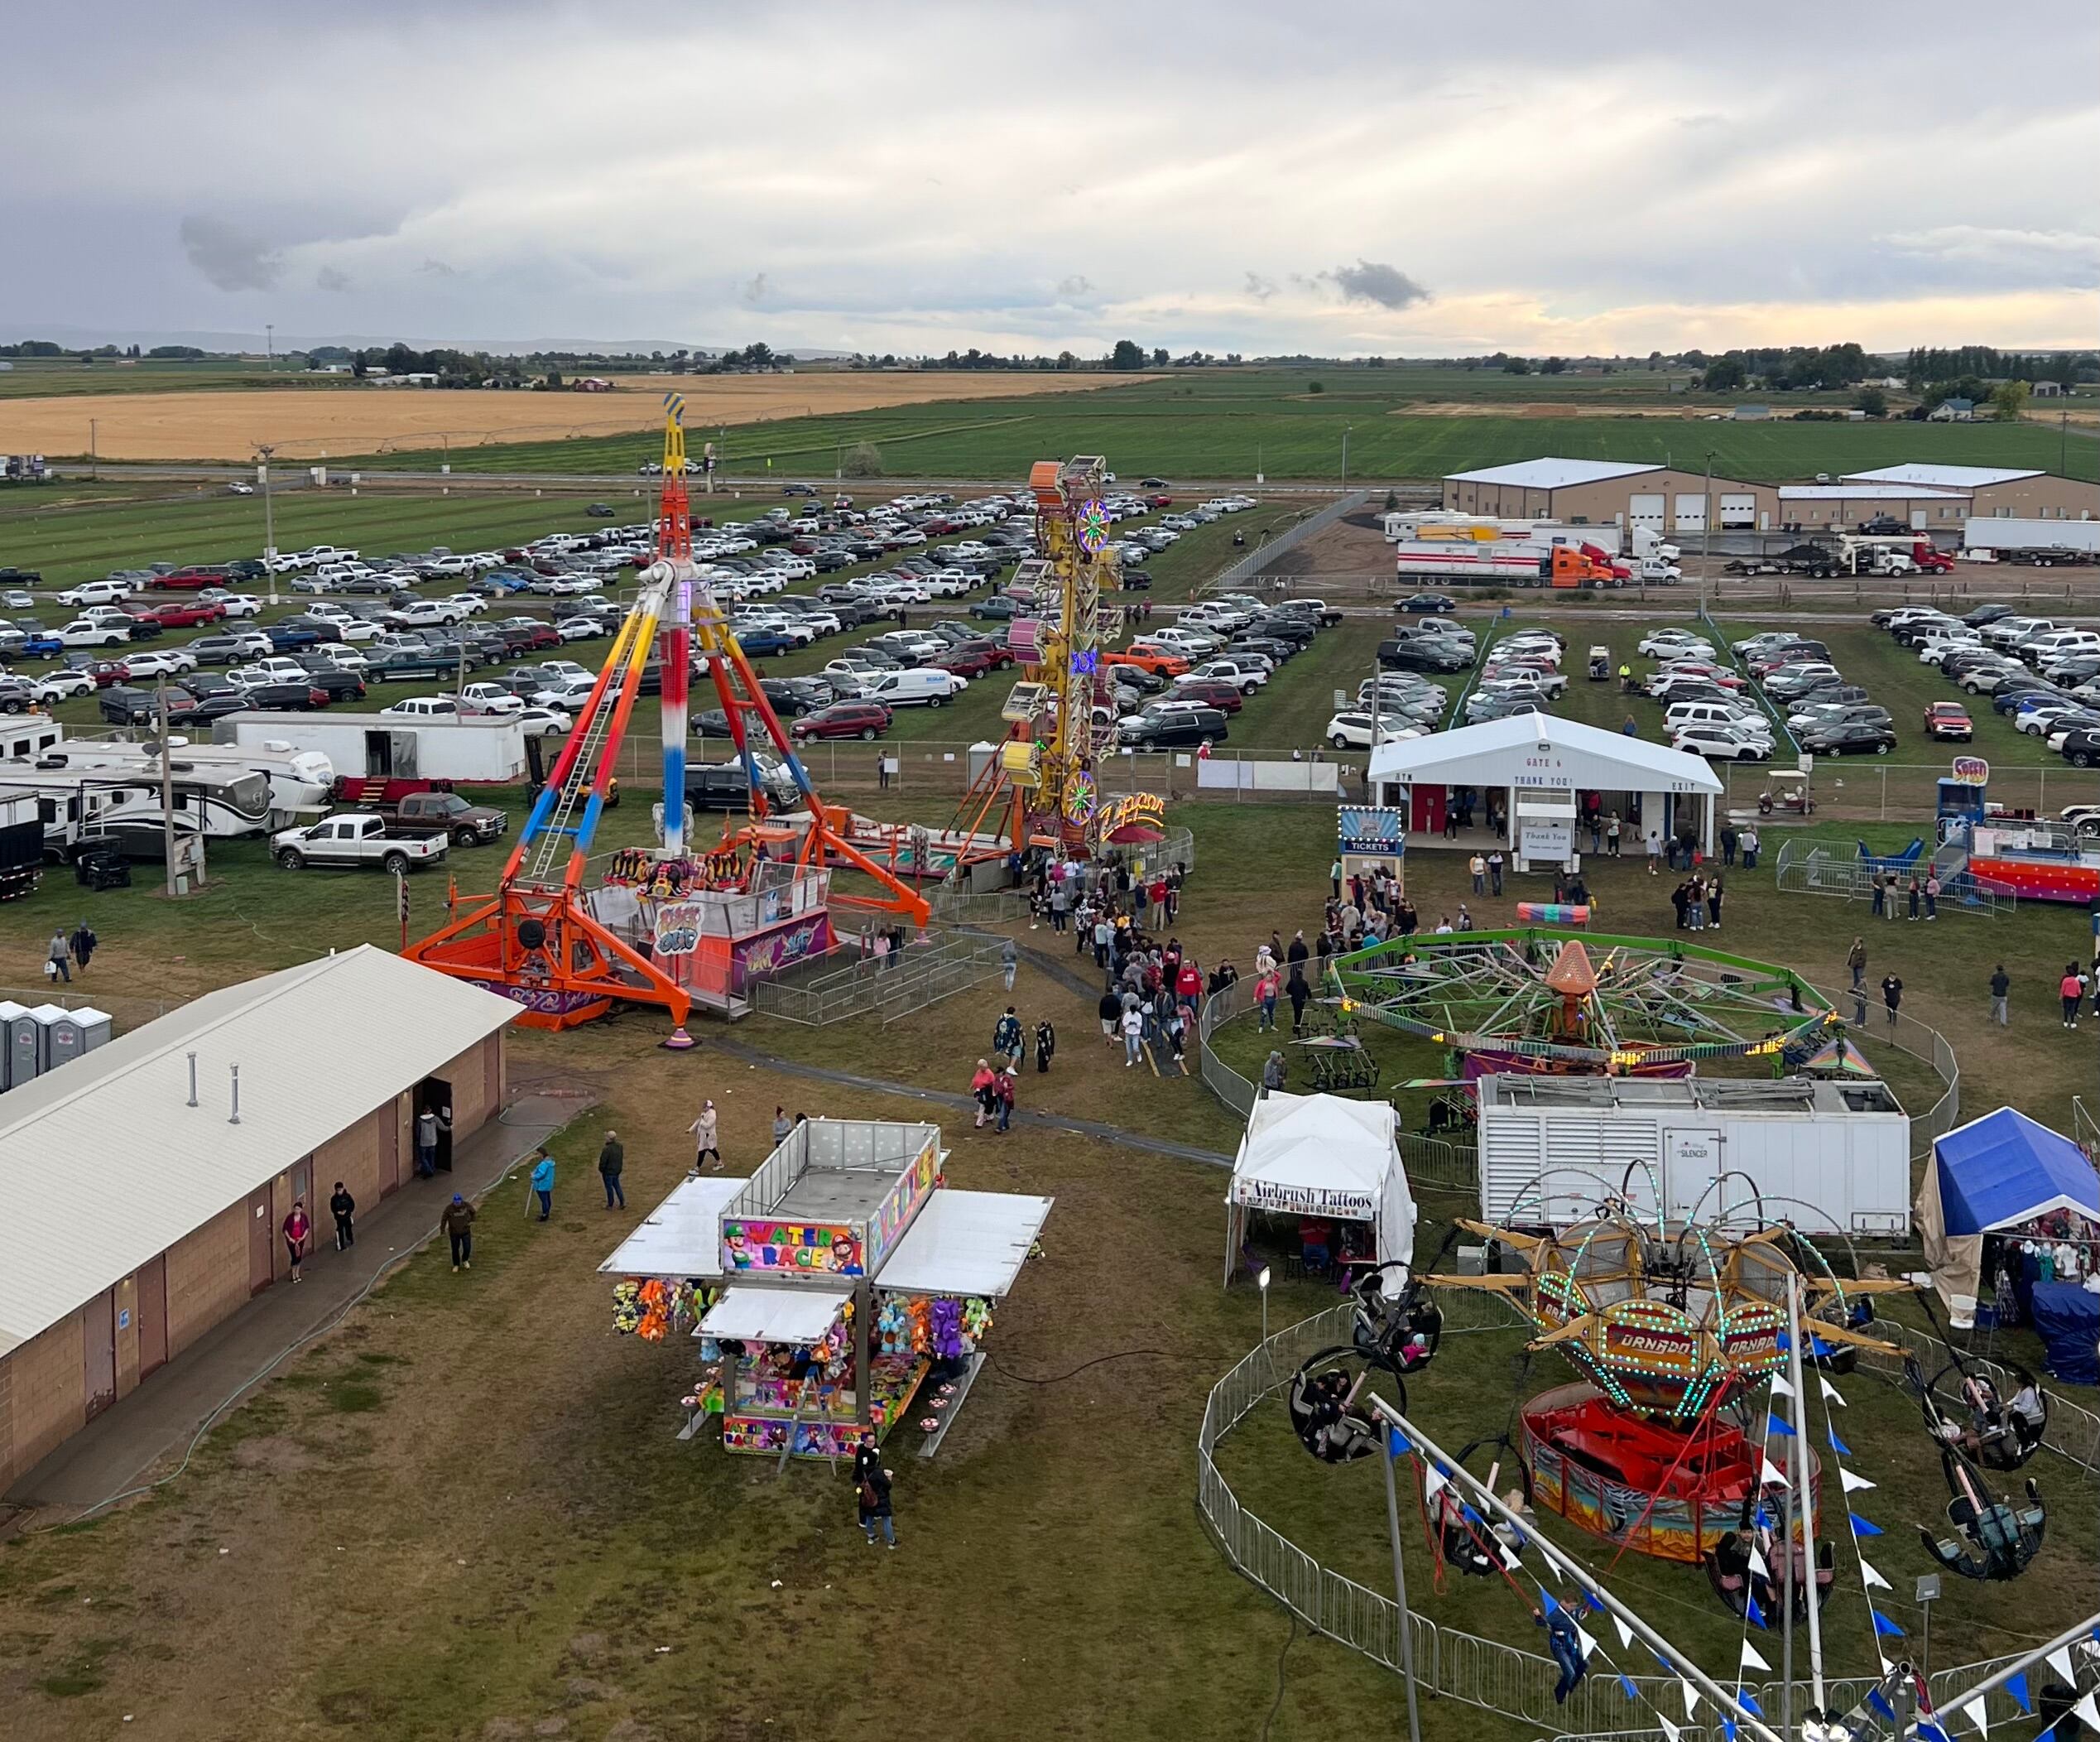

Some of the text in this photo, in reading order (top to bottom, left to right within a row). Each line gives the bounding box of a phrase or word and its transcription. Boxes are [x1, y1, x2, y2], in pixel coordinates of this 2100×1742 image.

[1526, 758, 1550, 767] GATE
[1395, 772, 1413, 781] ATM
[1515, 777, 1543, 785] THANK
[1672, 782, 1695, 791] EXIT
[1351, 842, 1389, 851] TICKETS
[1681, 1149, 1708, 1157] SILENCER
[1252, 1180, 1372, 1209] Airbrush Tattoos
[747, 1225, 833, 1247] WATER
[762, 1246, 824, 1268] RACE
